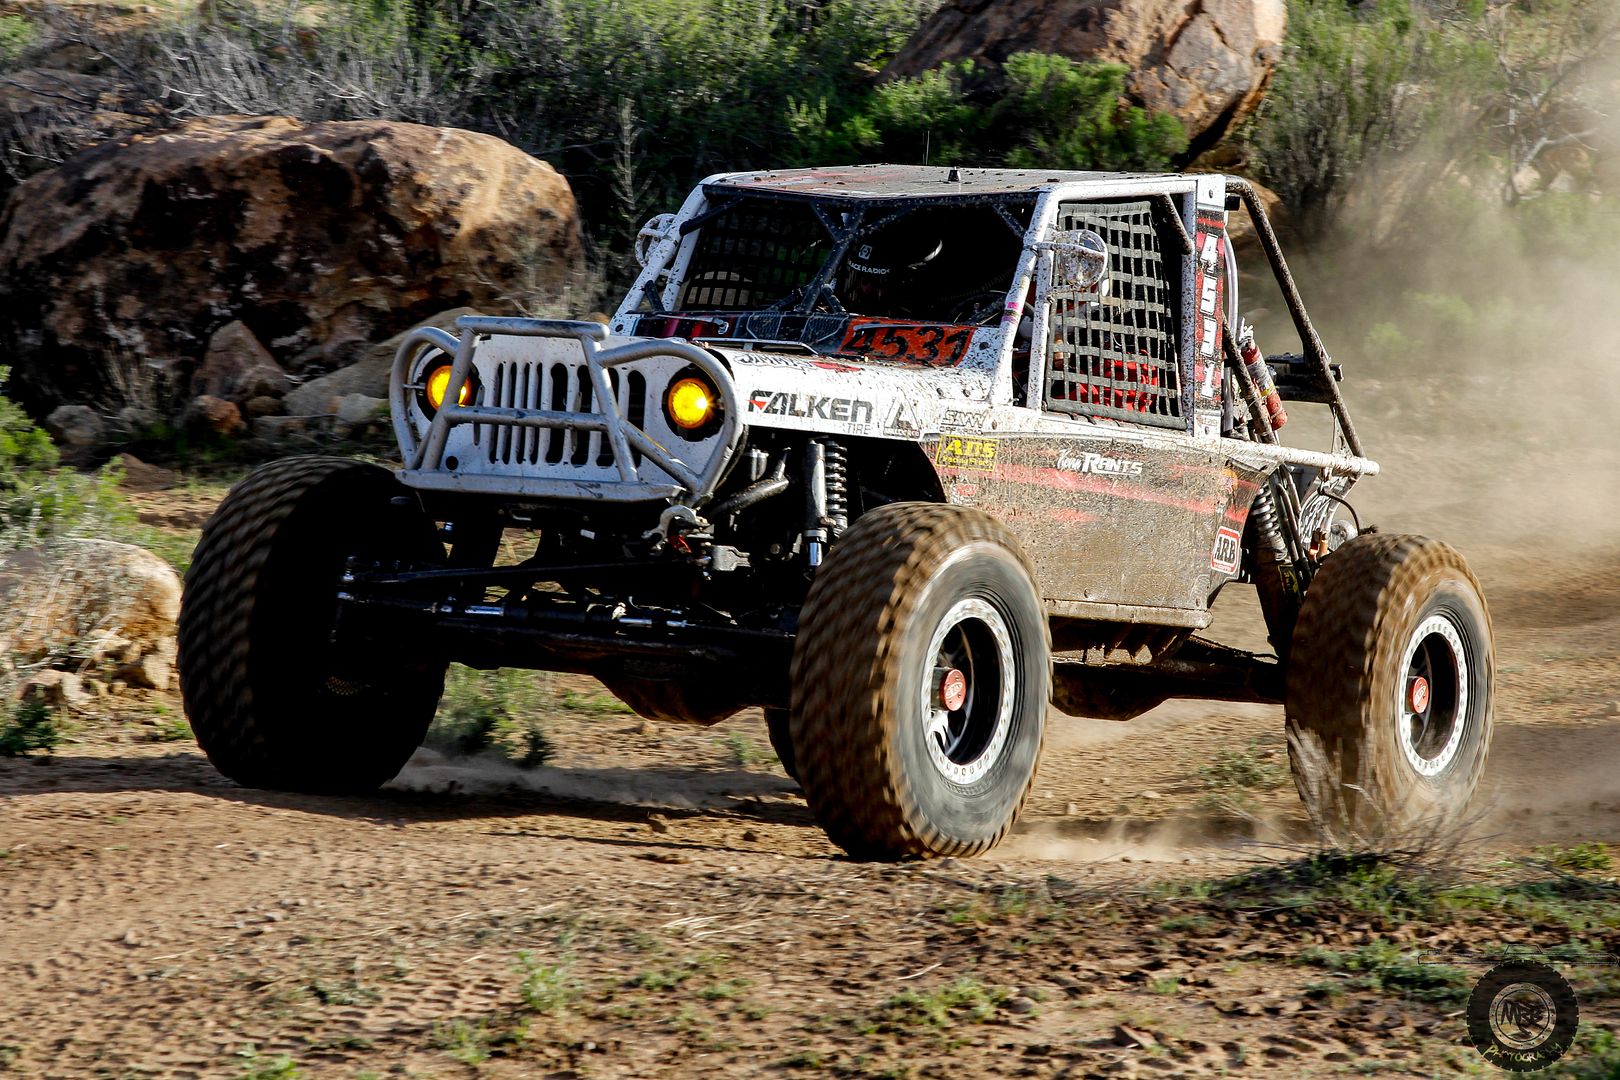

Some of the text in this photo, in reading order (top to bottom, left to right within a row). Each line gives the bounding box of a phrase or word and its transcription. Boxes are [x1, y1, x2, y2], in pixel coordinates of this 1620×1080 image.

[841, 326, 970, 361] 4531
[748, 389, 873, 424] FALKEN
[1214, 536, 1236, 563] ARB
